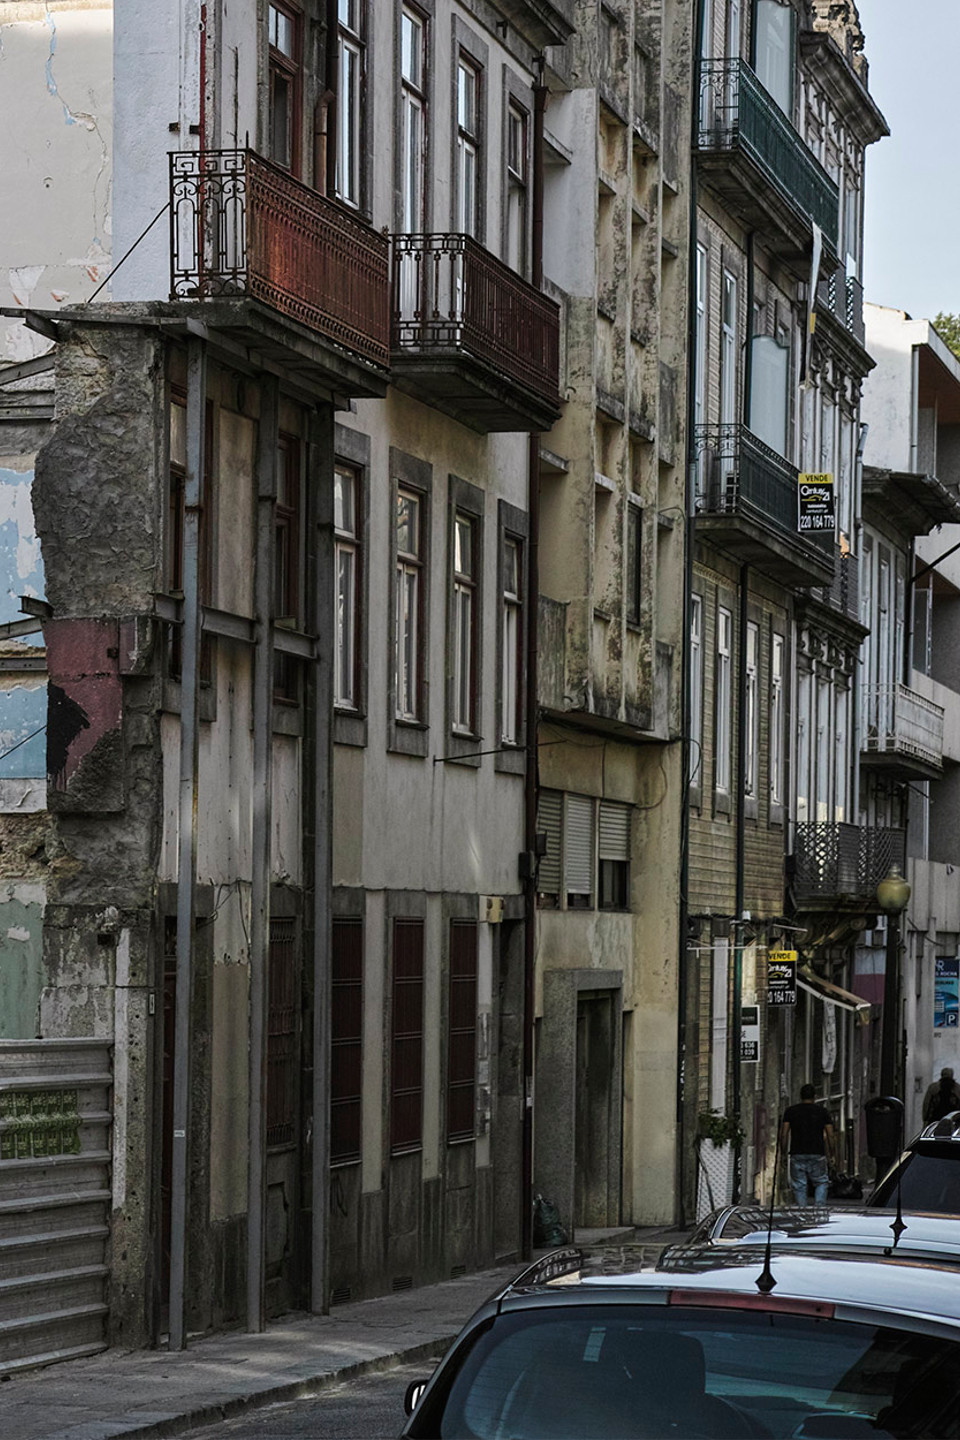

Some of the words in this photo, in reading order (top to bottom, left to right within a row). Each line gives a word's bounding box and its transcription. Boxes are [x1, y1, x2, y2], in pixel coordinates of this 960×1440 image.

[805, 474, 828, 482] VENDE
[800, 515, 811, 528] 220
[812, 515, 823, 528] 164
[824, 515, 834, 528] 779
[774, 991, 784, 1003] 164
[785, 991, 795, 1003] 779
[948, 1014, 955, 1024] P
